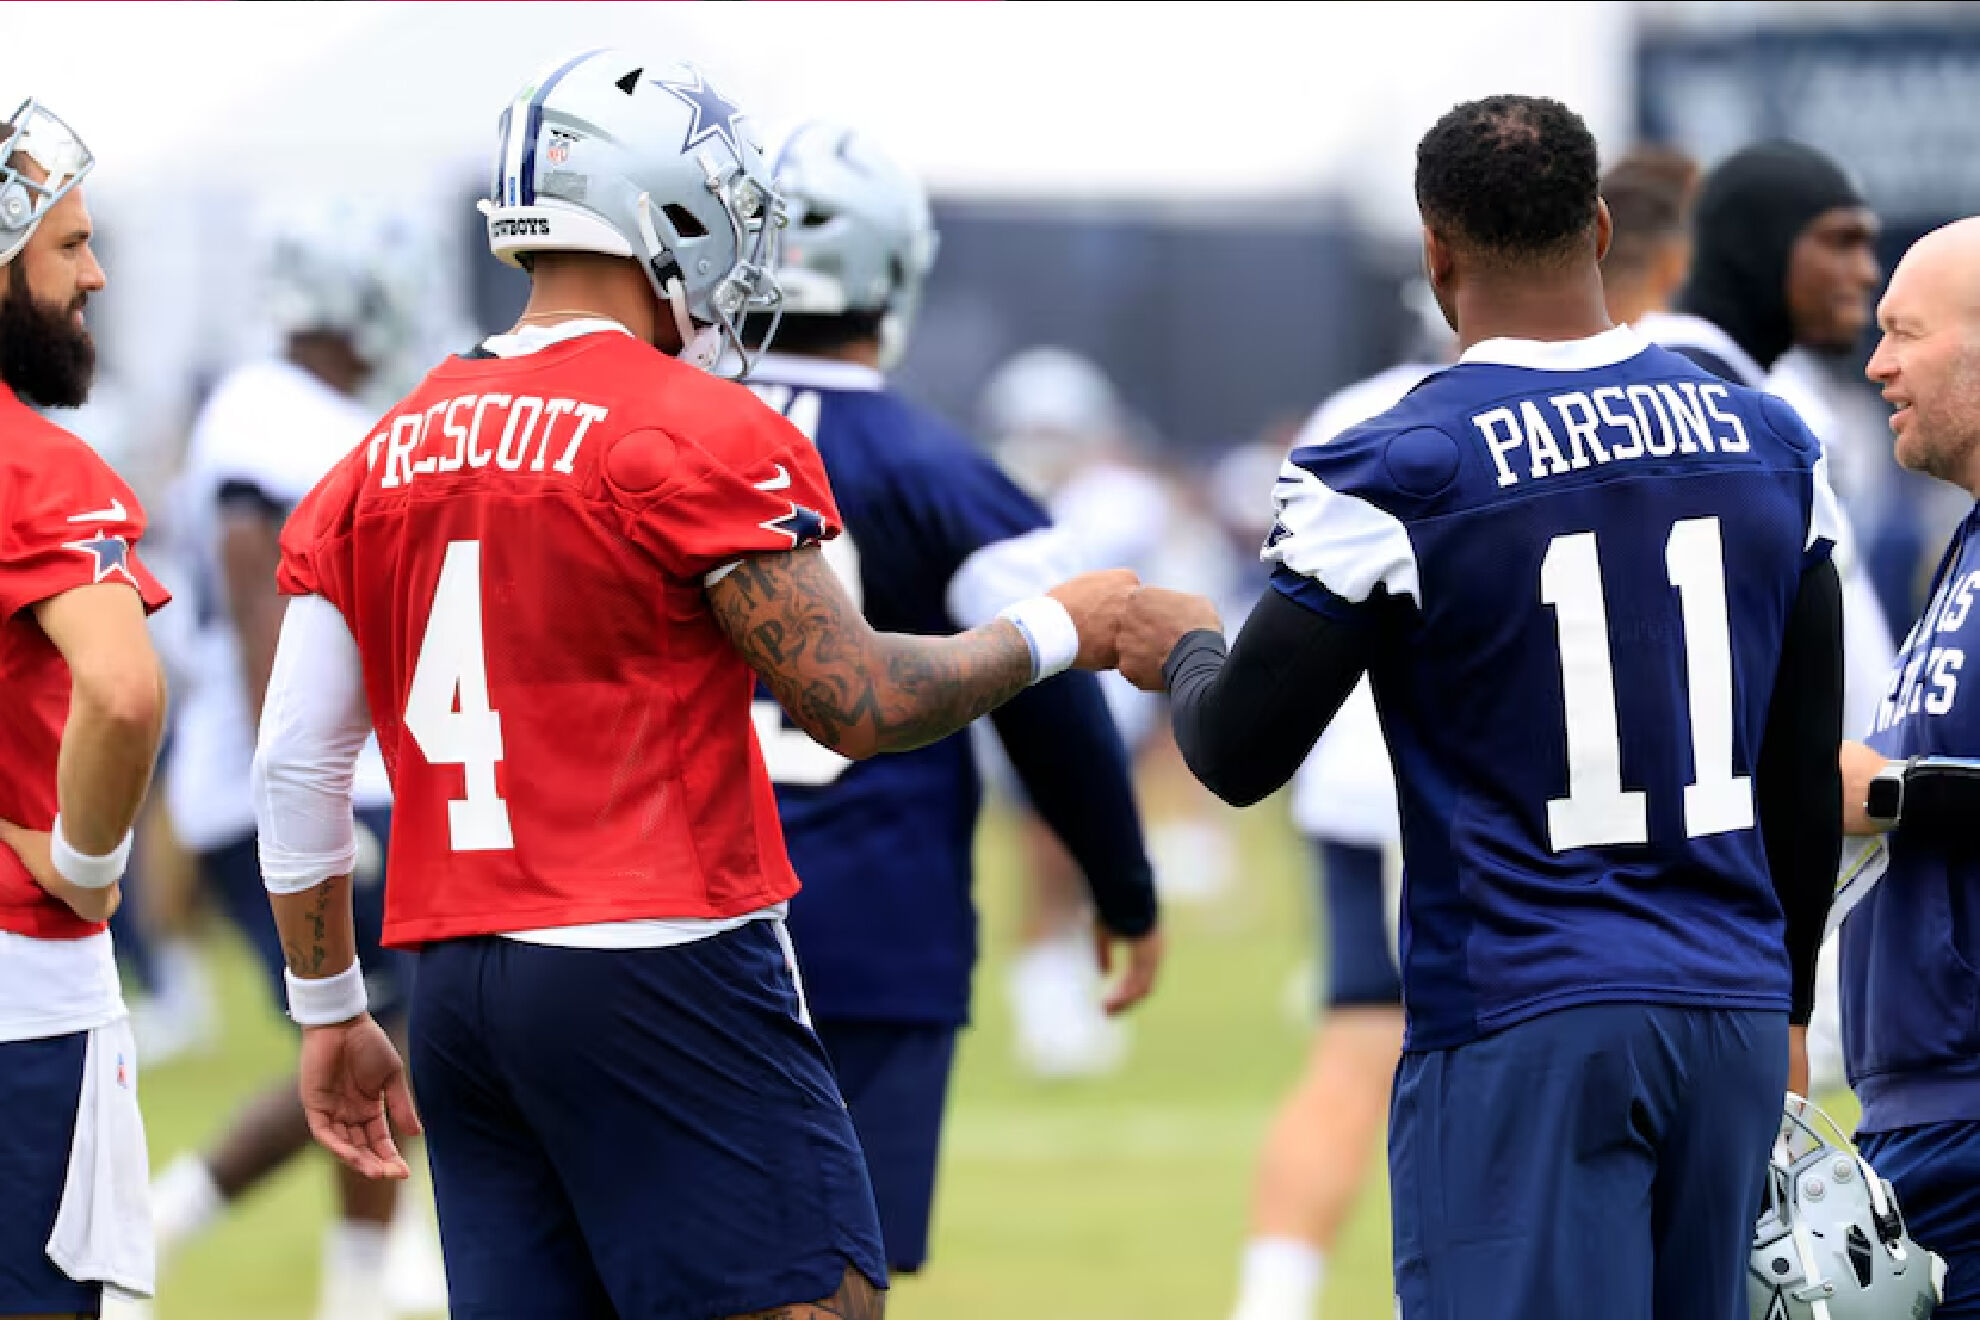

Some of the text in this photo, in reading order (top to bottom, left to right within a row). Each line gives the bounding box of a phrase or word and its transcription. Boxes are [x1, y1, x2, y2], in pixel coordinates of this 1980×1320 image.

[1471, 382, 1751, 488] PARSONS
[403, 539, 515, 850] 4
[1540, 515, 1755, 853] 11
